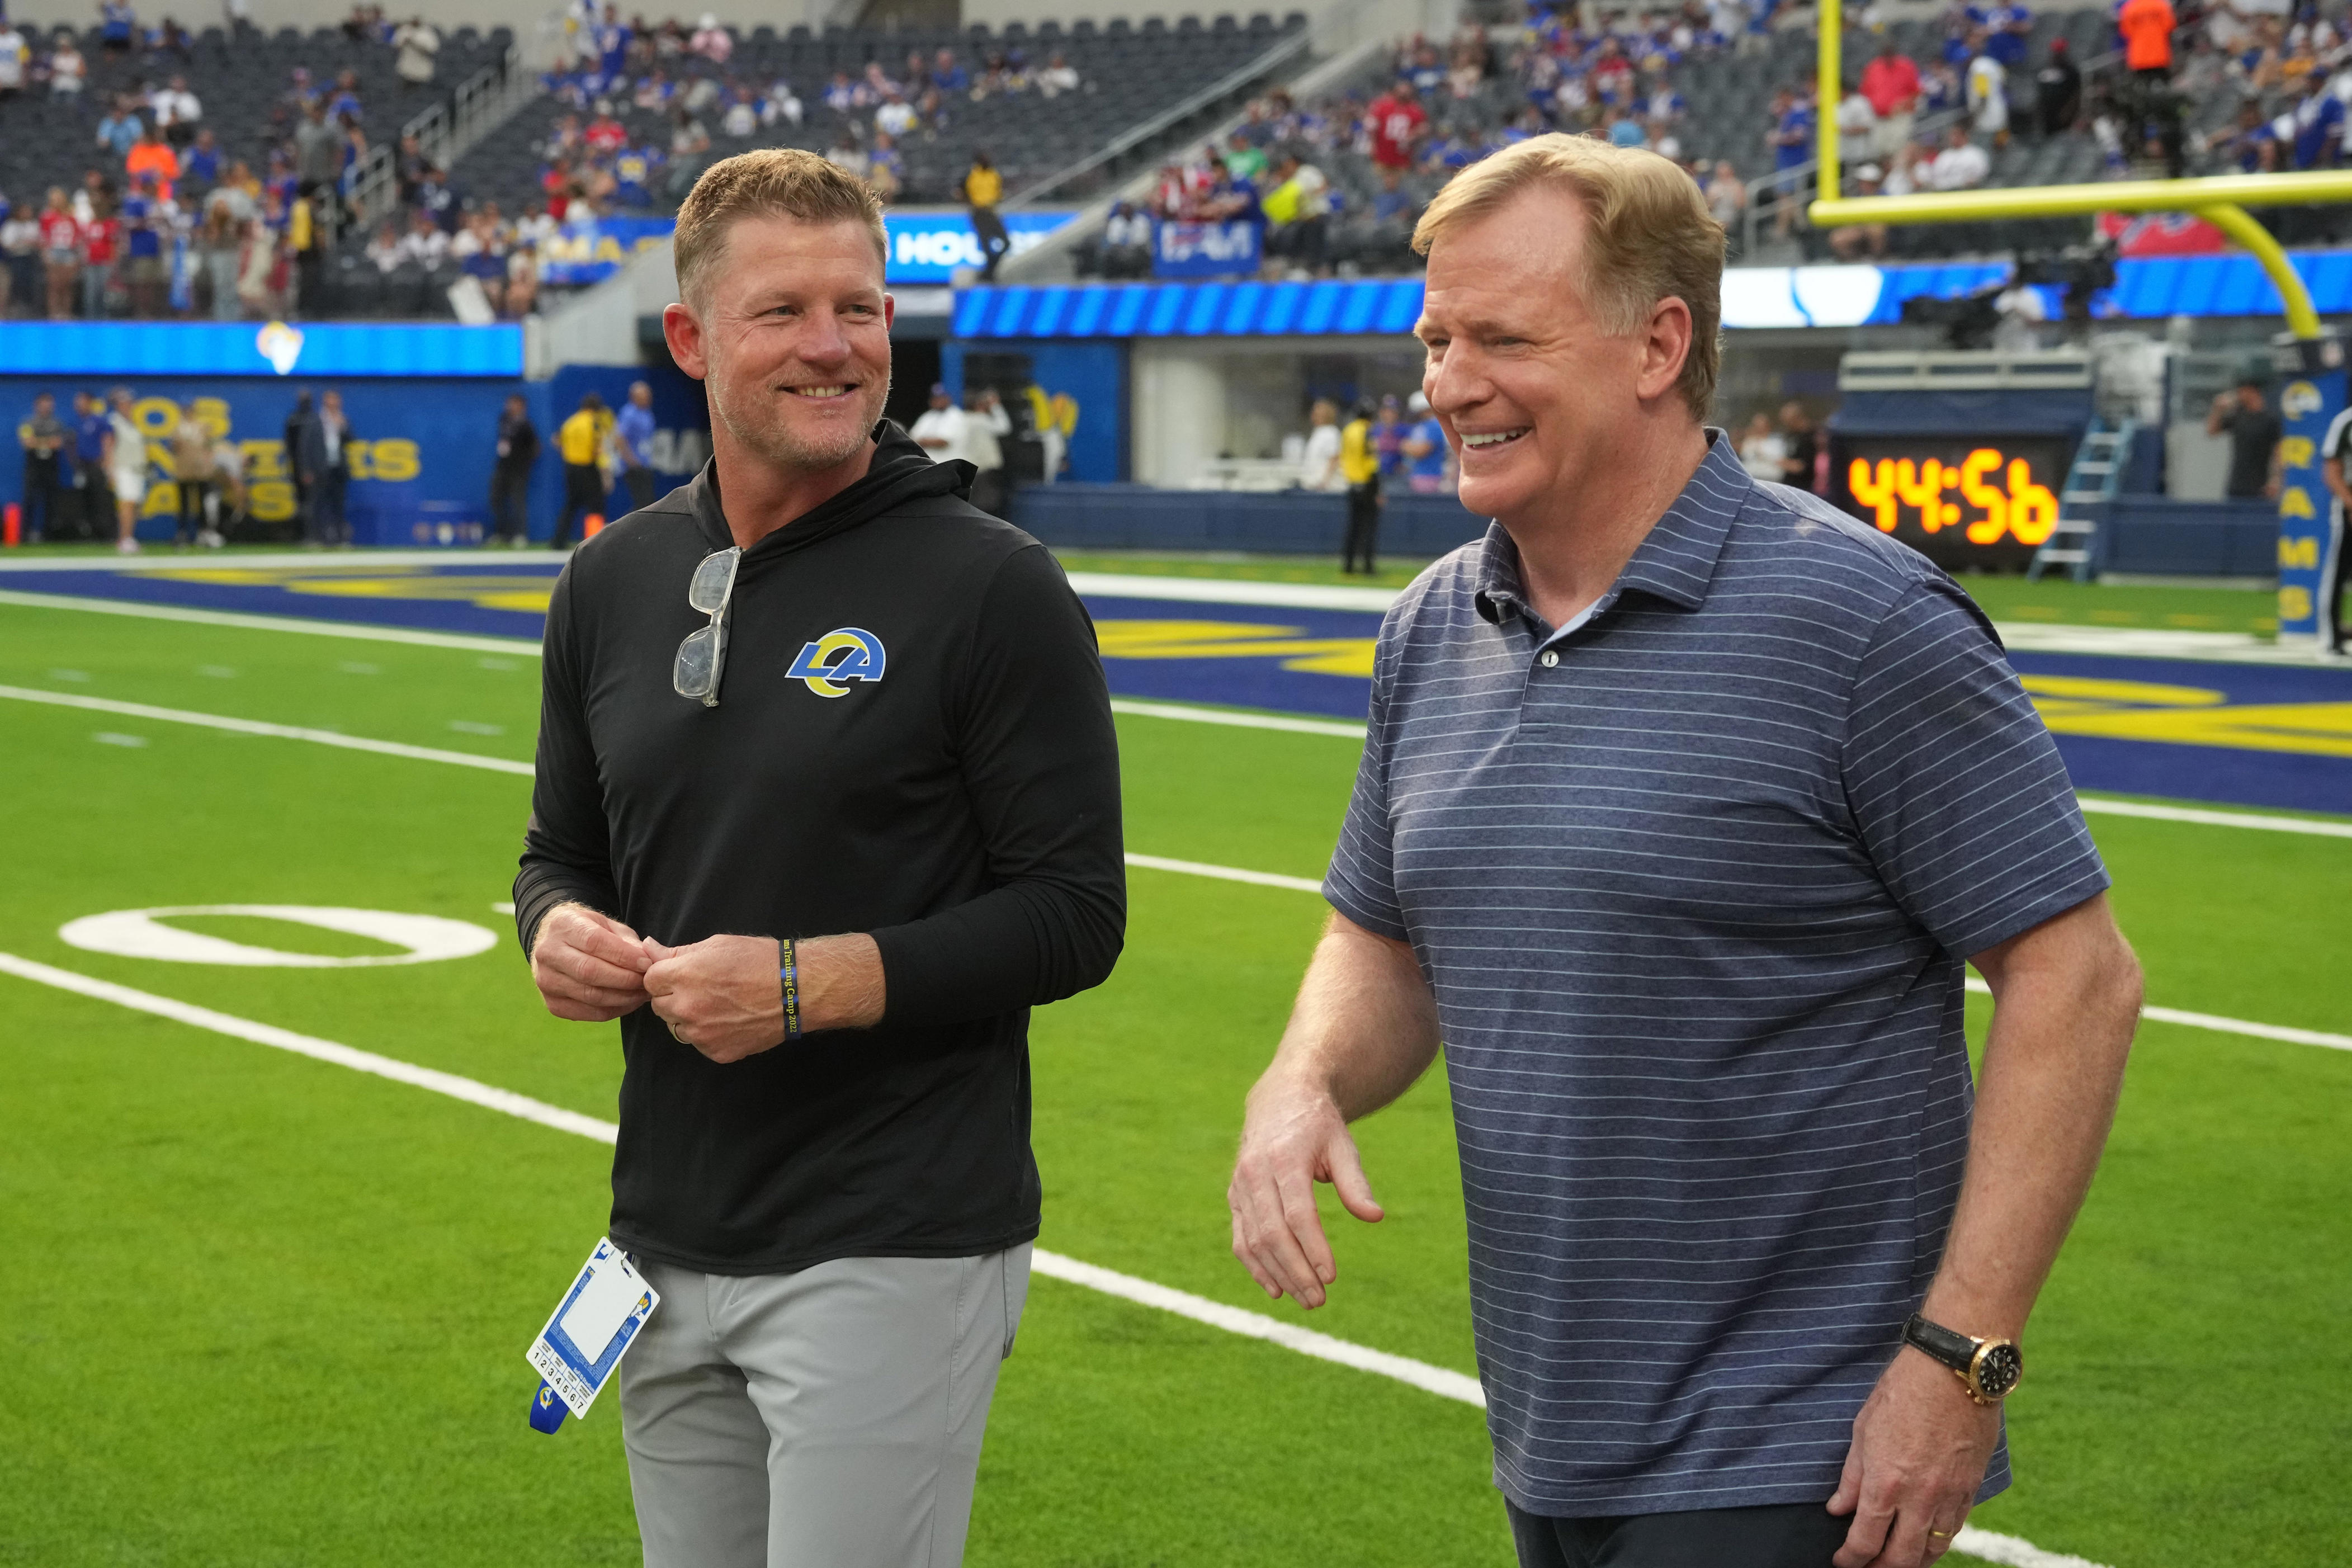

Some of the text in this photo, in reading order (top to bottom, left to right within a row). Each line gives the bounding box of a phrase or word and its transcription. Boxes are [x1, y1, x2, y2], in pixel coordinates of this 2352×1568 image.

[1849, 448, 2058, 545] 44:56
[784, 950, 794, 987] Training
[786, 988, 795, 1014] Camp
[788, 1015, 797, 1033] 2022
[540, 1360, 547, 1368] 2
[582, 1377, 595, 1393] Stadium
